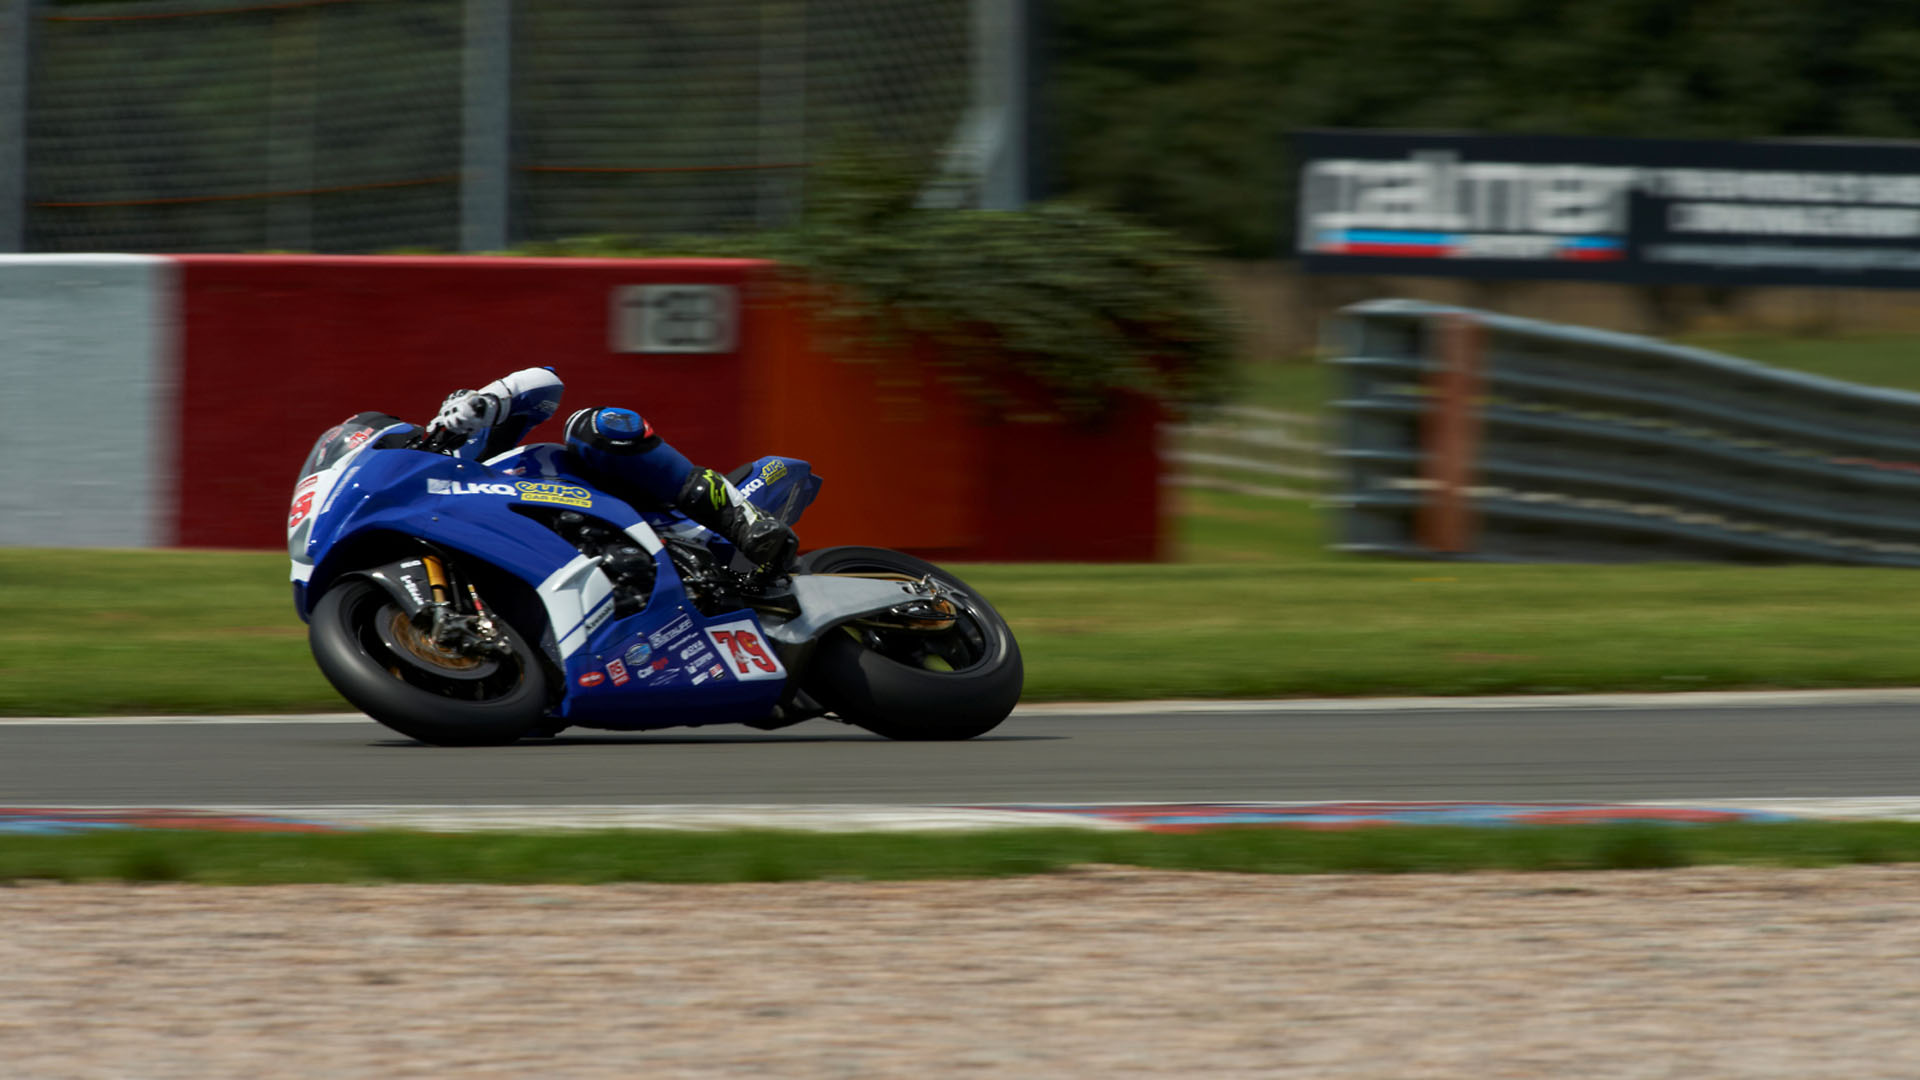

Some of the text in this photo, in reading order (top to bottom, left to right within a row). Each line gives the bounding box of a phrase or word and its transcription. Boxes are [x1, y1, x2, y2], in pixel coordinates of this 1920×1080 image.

[451, 481, 592, 500] LKQ euro
[710, 629, 777, 674] 79
